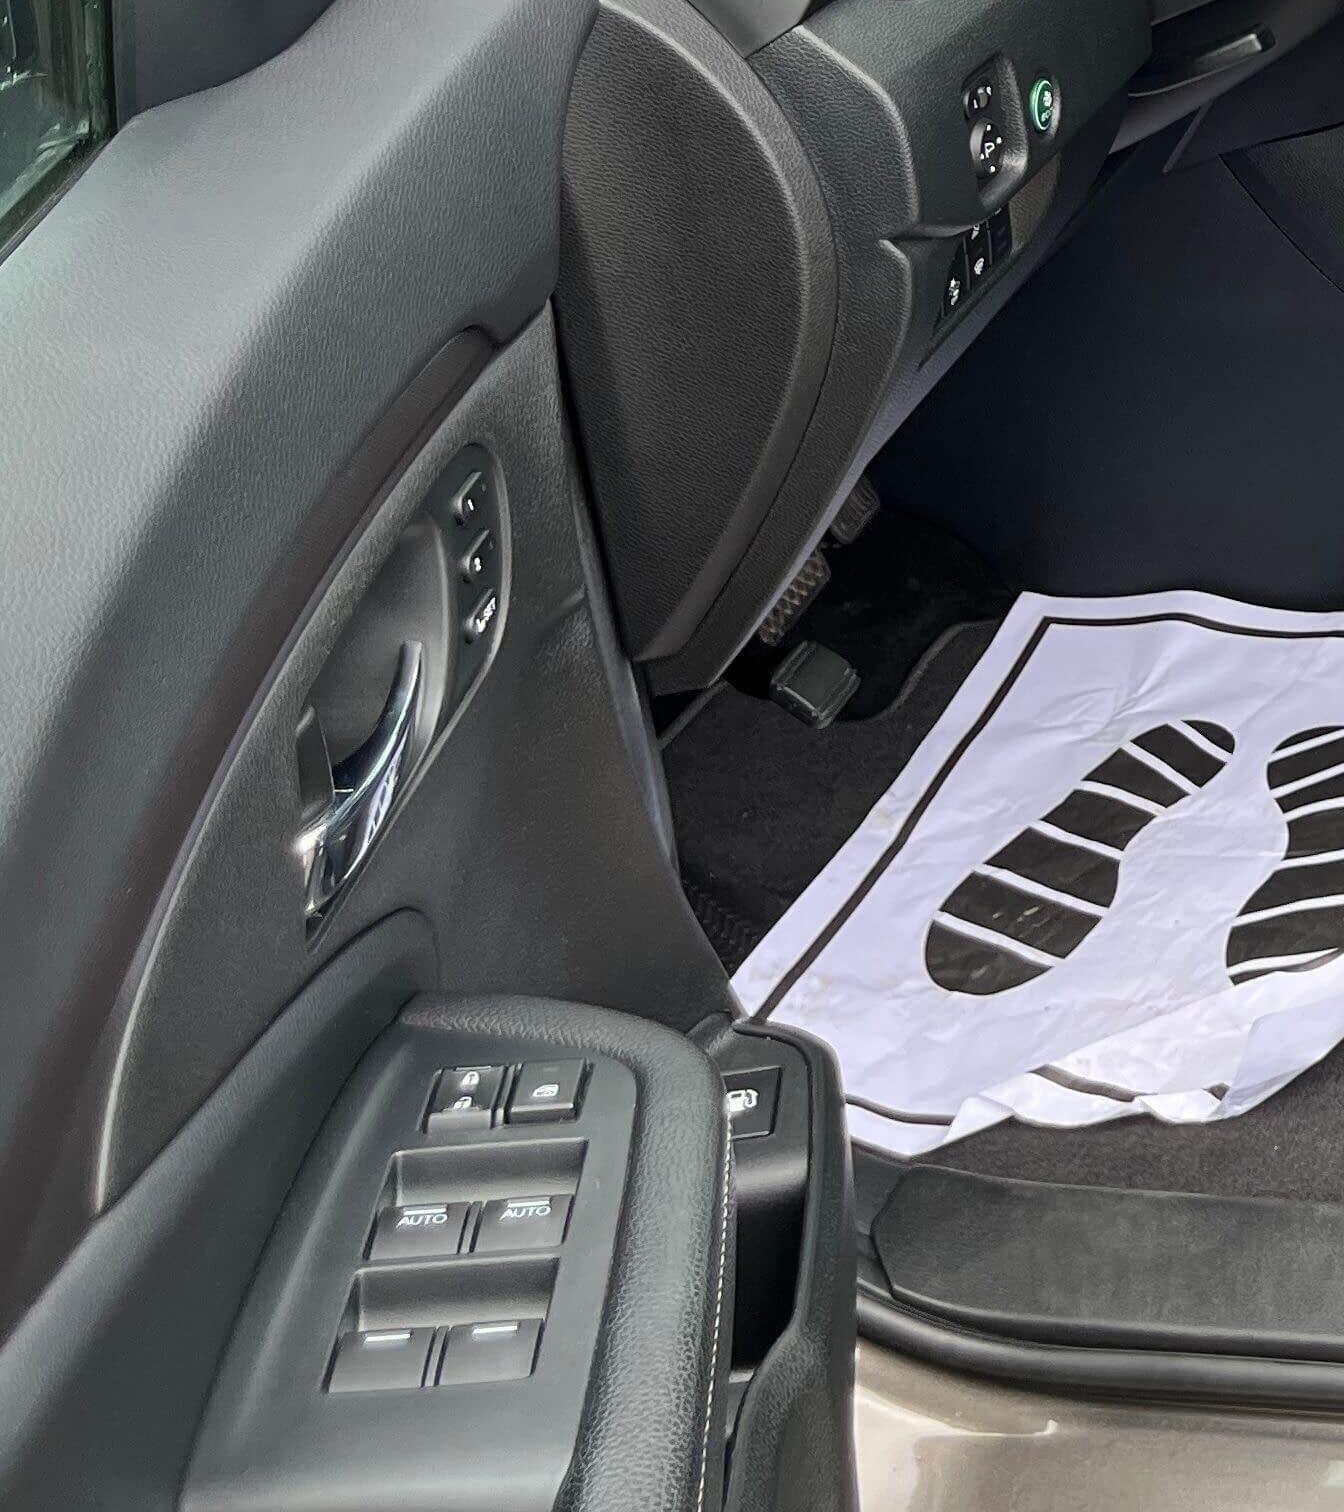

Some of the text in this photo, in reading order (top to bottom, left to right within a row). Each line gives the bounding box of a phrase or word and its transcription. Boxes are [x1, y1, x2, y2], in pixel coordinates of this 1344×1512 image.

[984, 142, 995, 159] P
[396, 1205, 551, 1228] AUTO AUTO
